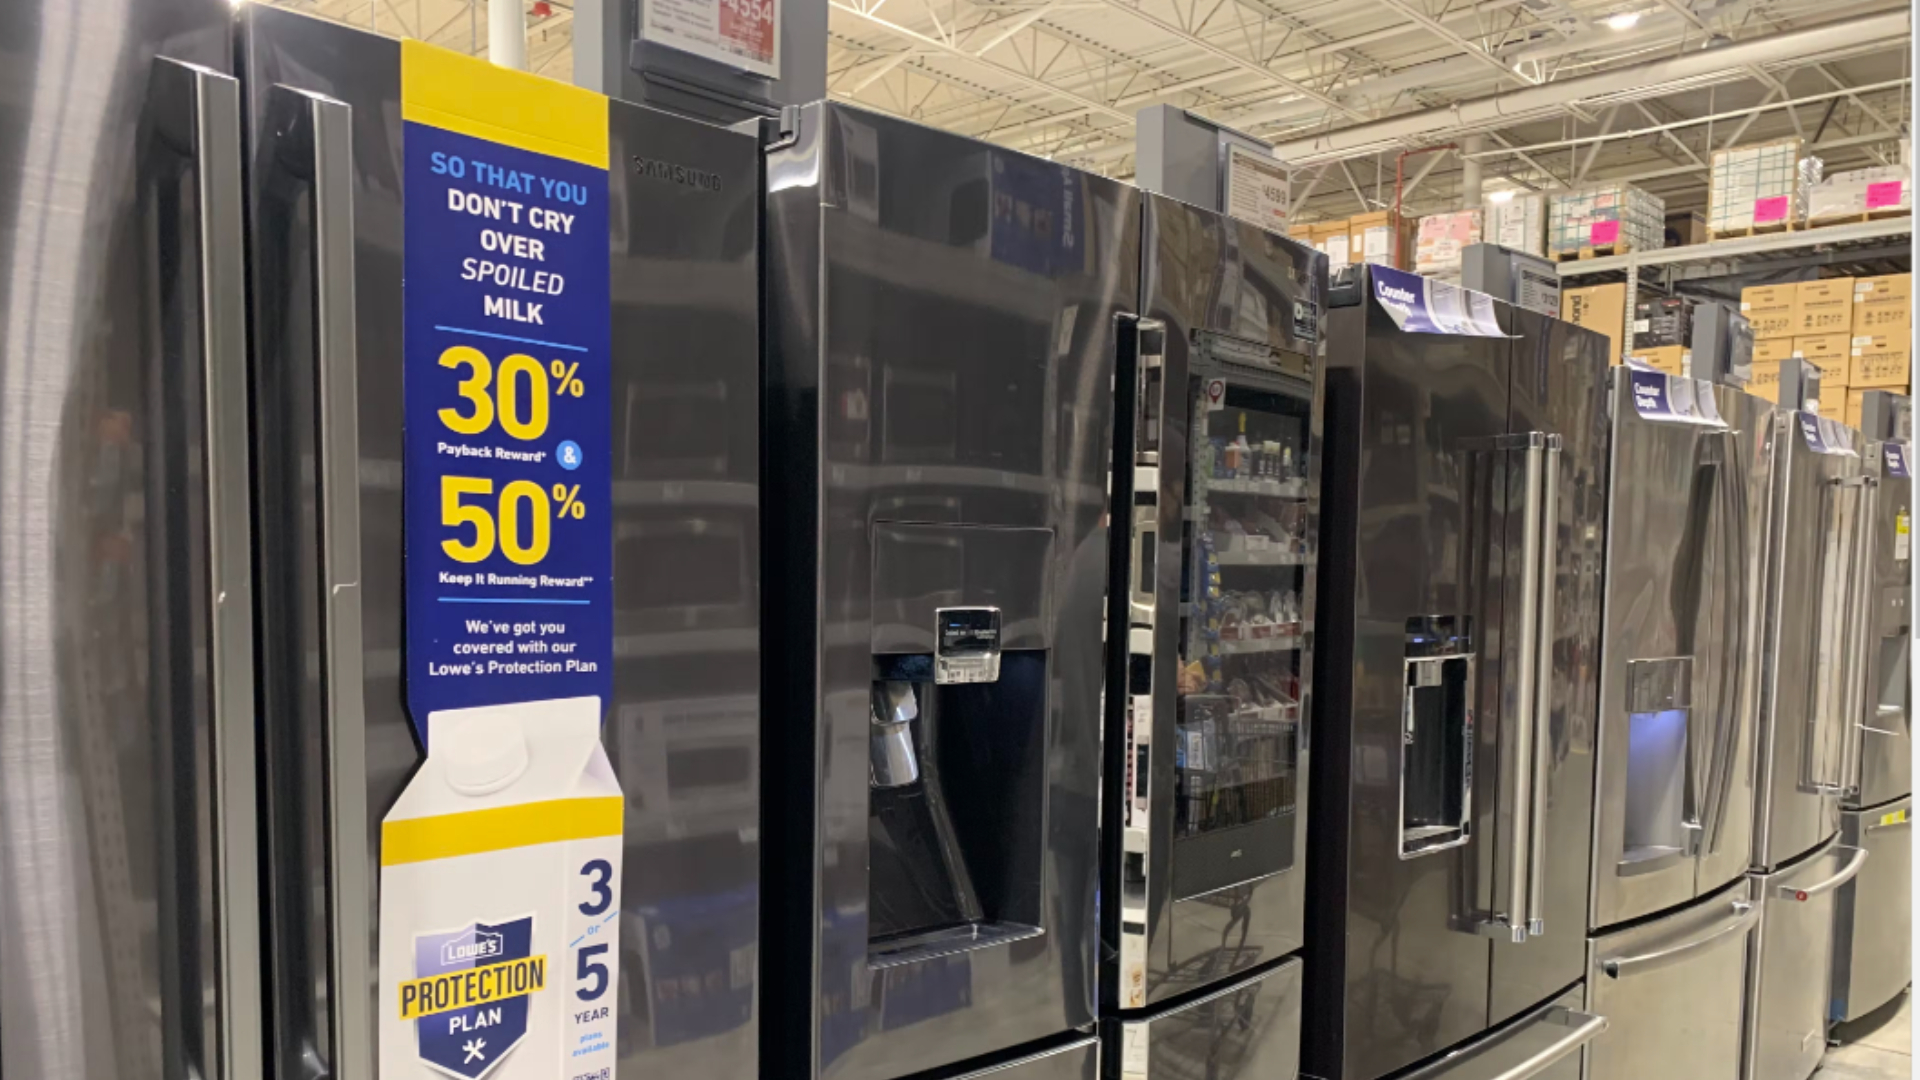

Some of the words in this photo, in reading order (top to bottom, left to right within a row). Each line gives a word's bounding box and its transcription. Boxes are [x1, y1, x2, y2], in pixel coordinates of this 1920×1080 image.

[430, 151, 466, 179] SO
[471, 160, 536, 195] THAT
[540, 177, 587, 206] YOU
[633, 155, 722, 192] SAMSUNG
[447, 187, 523, 225] DON'T
[528, 206, 576, 235] CRY
[480, 228, 546, 262] OVER
[460, 257, 565, 296] SPOILED
[1377, 280, 1416, 304] Counter
[483, 294, 544, 326] MILK
[437, 345, 585, 440] 30%
[437, 441, 493, 459] Payback
[563, 445, 577, 464] &
[440, 475, 586, 565] 50%
[438, 571, 473, 587] Keep
[475, 572, 485, 585] It
[487, 572, 537, 589] Running
[465, 619, 511, 634] We've
[513, 620, 536, 637] got
[539, 622, 566, 637] you
[452, 640, 515, 655] covered
[517, 640, 549, 654] with
[550, 643, 578, 654] our
[429, 661, 485, 676] Lowe's
[487, 660, 563, 675] Protection
[564, 658, 598, 673] Plan
[578, 858, 613, 916] 3
[587, 925, 601, 936] or
[448, 938, 498, 960] LOWE'S
[575, 942, 610, 1002] 5
[401, 958, 545, 1017] PROTECTION
[449, 1007, 502, 1036] PLAN
[574, 1006, 609, 1025] YEAR
